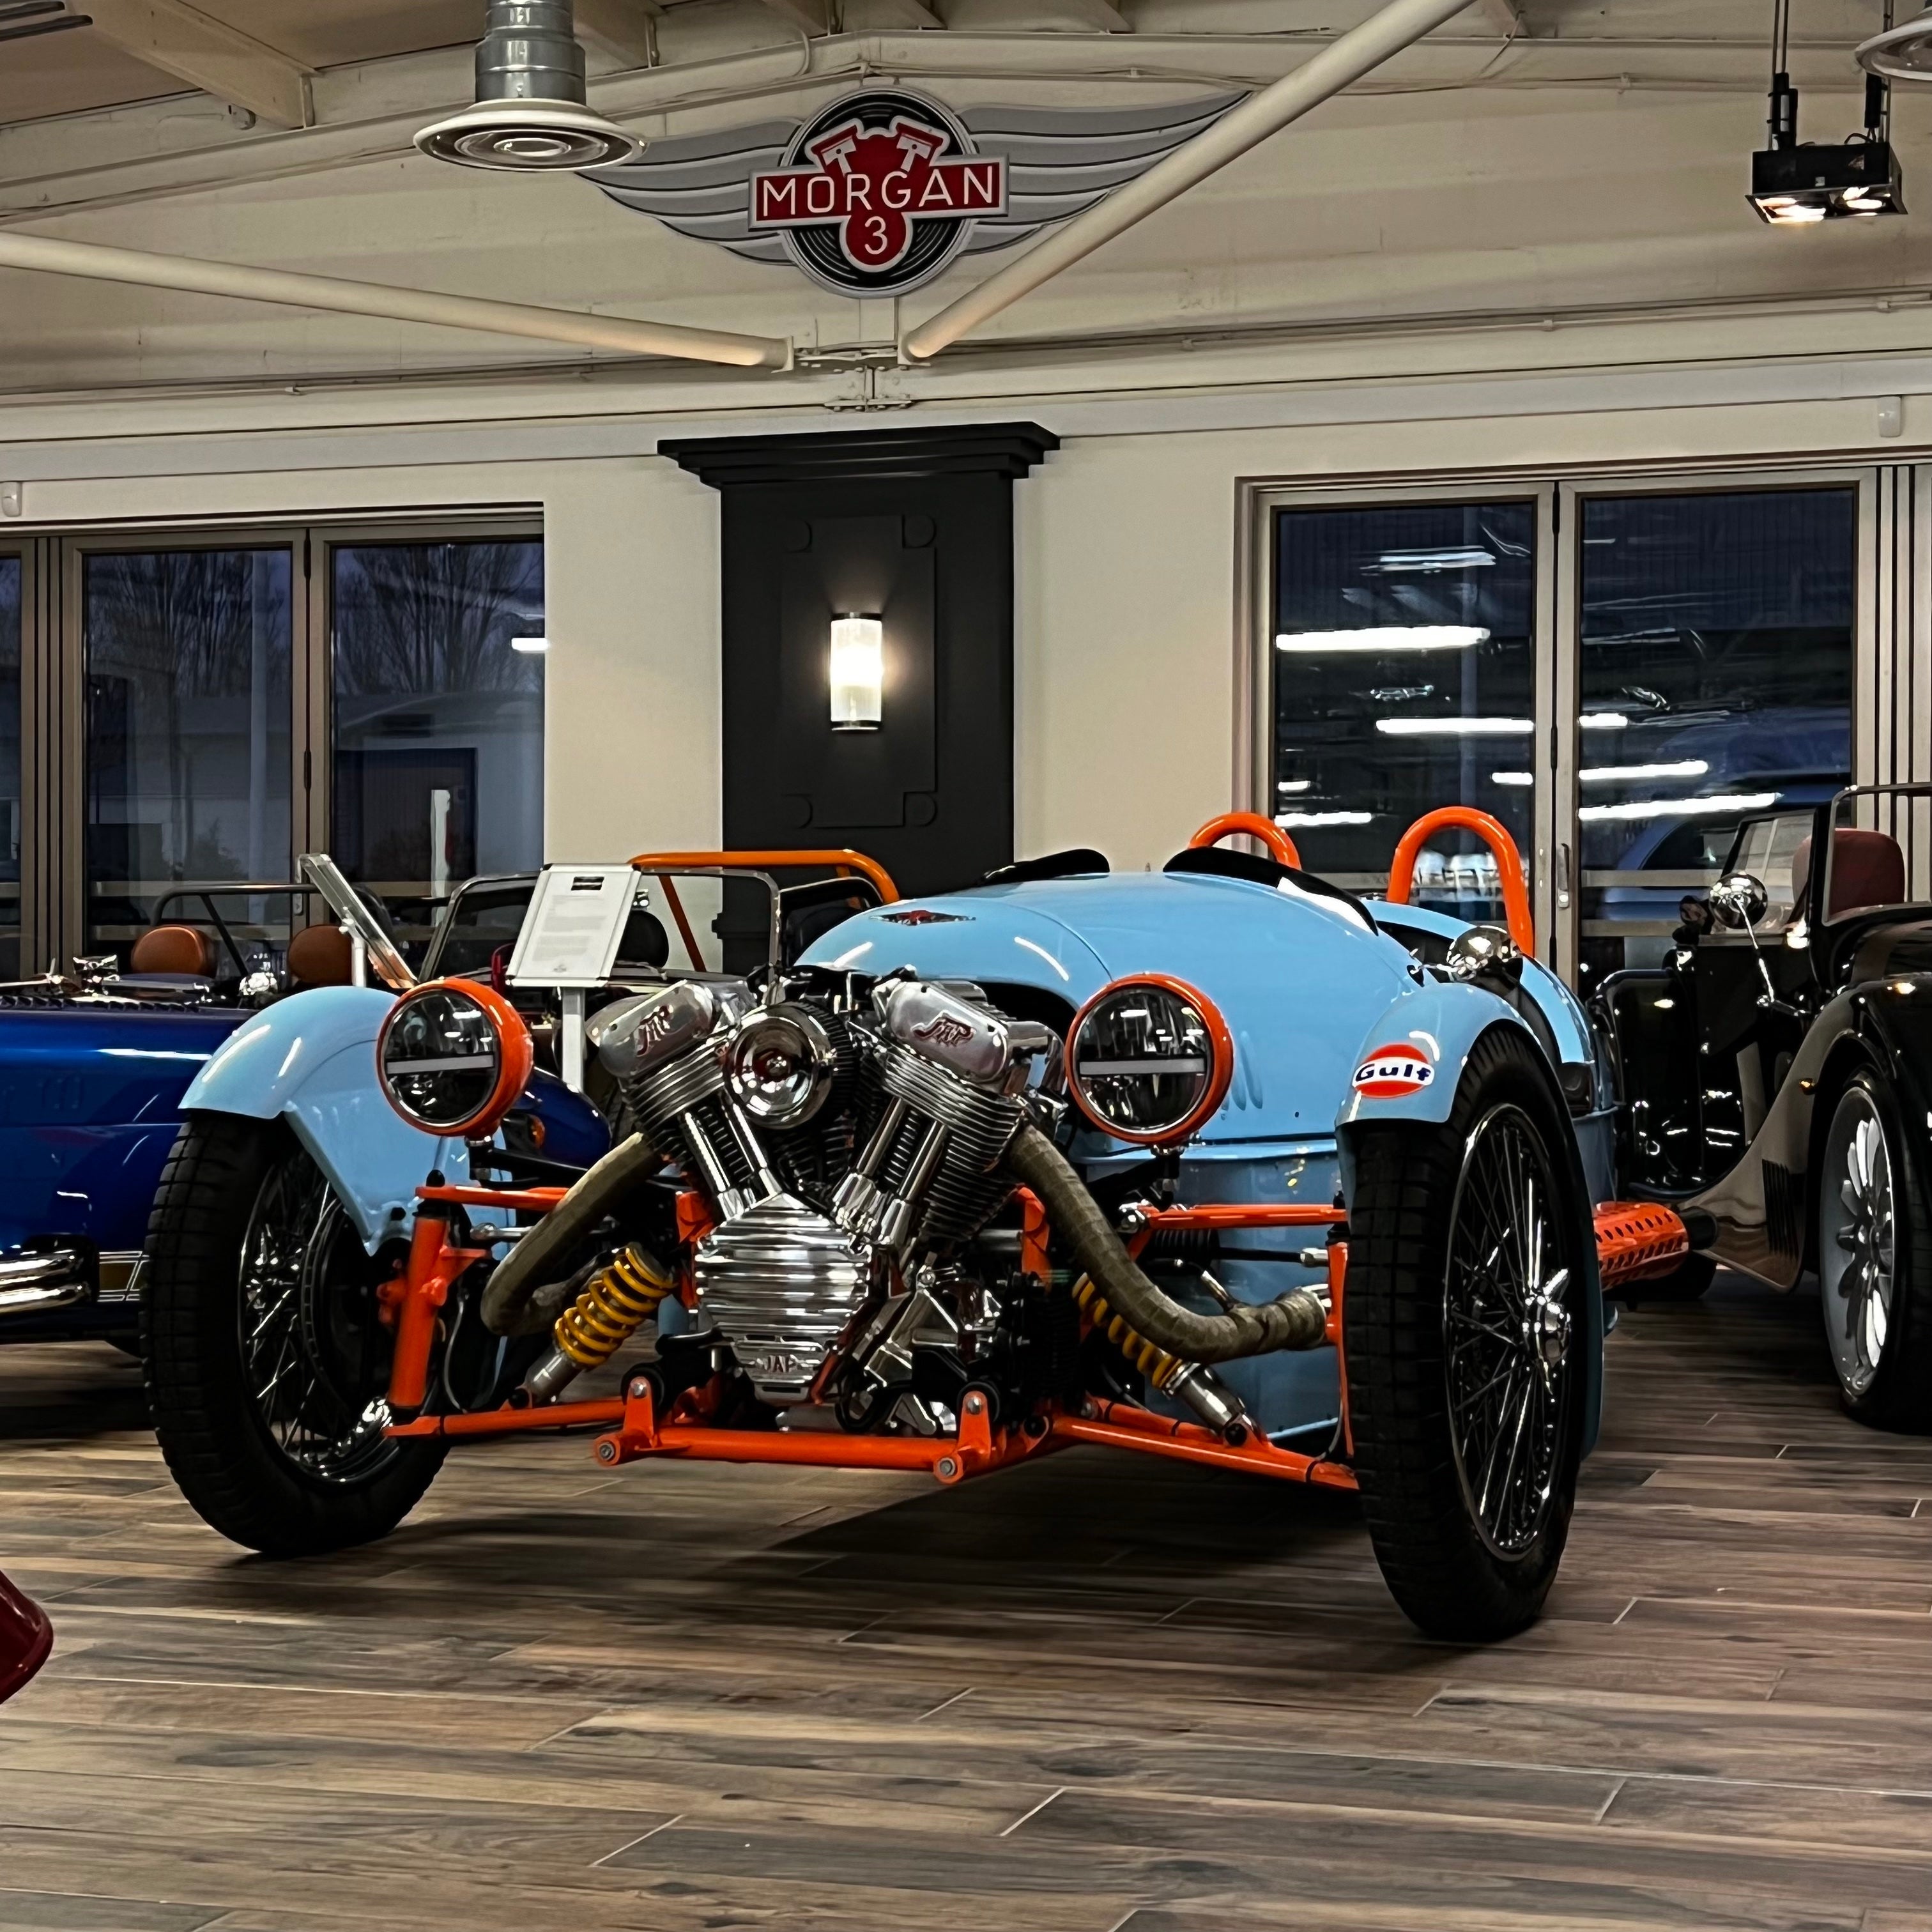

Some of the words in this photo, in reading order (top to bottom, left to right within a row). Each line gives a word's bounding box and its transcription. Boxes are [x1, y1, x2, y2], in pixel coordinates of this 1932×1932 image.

[763, 165, 993, 217] MORGAN
[864, 215, 887, 255] 3
[1355, 1063, 1431, 1082] Gulf
